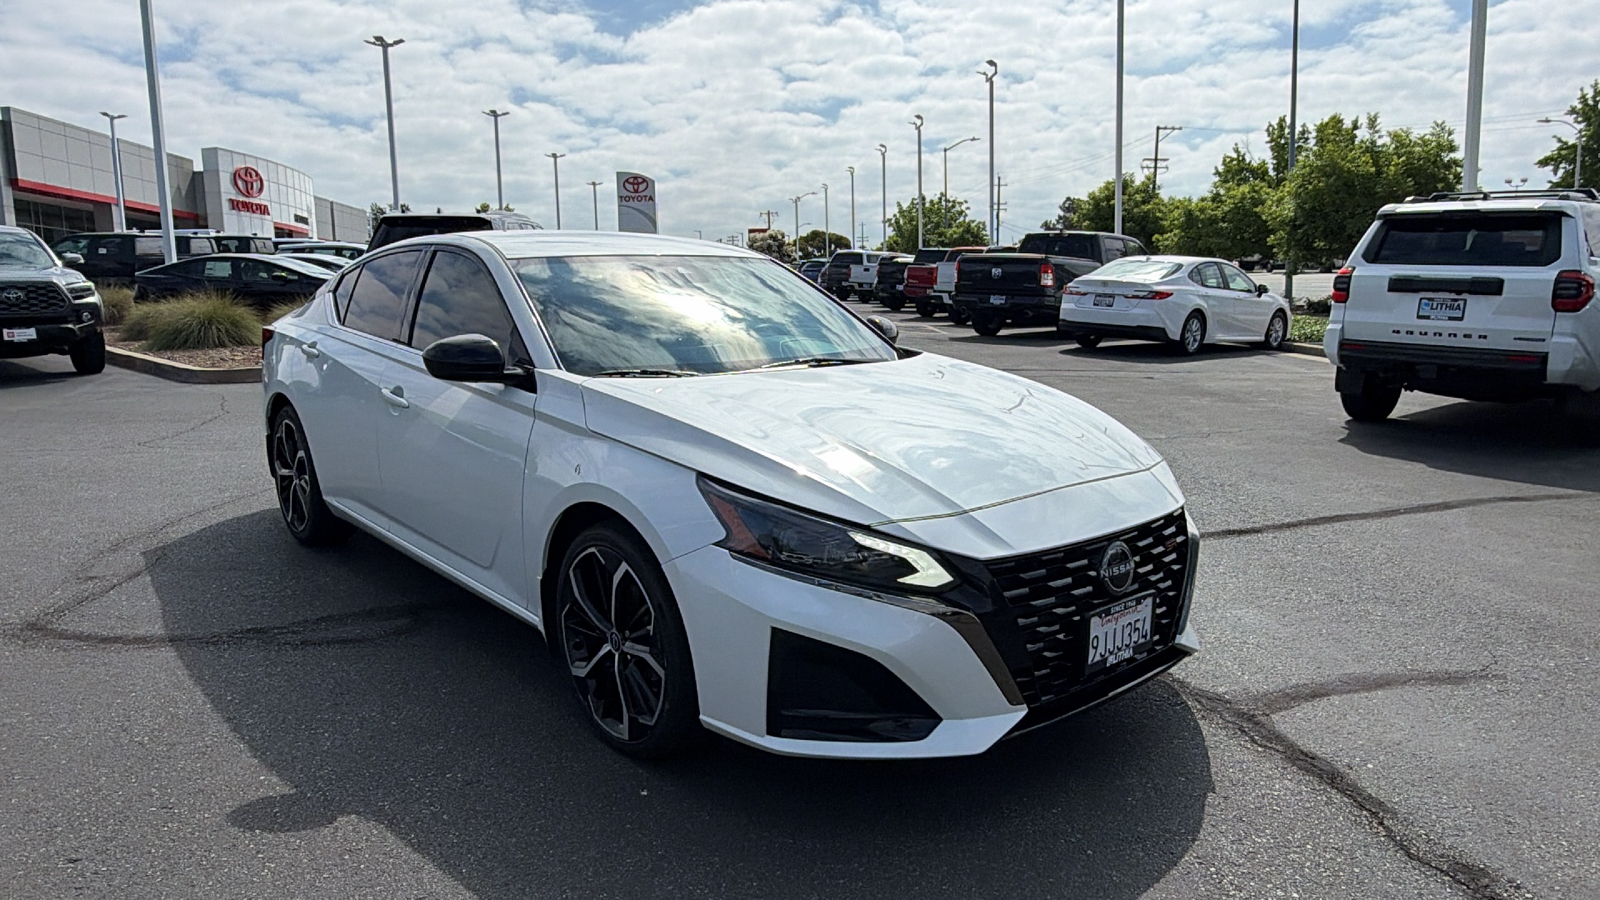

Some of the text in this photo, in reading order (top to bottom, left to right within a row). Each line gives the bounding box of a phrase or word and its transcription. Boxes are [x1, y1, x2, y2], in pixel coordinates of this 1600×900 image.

[619, 195, 654, 203] TOYOTA
[229, 198, 271, 216] TOYOTA
[1430, 302, 1461, 311] LITHIA
[1391, 329, 1488, 340] 4RUNNER
[1110, 603, 1125, 614] SINCE
[1091, 616, 1148, 663] 9JJJ354
